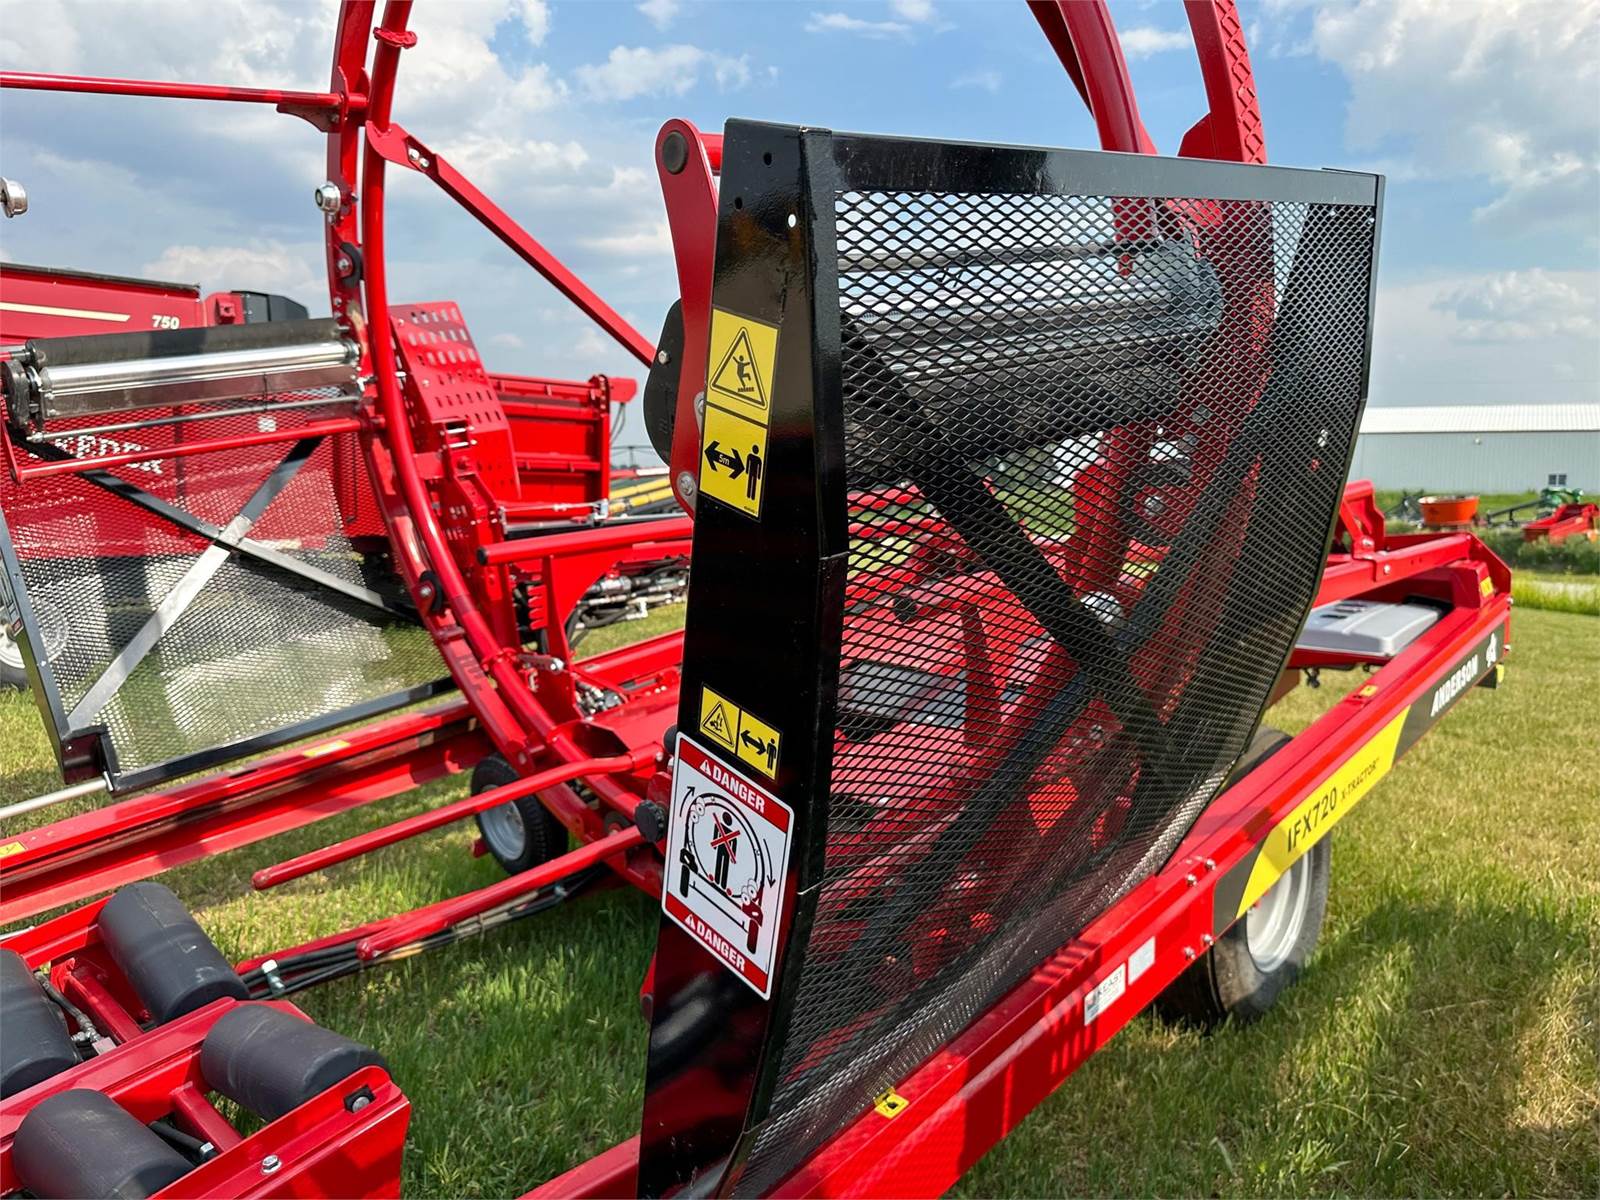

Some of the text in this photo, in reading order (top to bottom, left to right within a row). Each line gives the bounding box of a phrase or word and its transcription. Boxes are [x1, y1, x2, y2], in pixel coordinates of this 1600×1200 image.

[152, 314, 180, 330] 750
[718, 454, 730, 466] 5m
[1430, 654, 1478, 717] ANDERSON
[712, 764, 766, 814] DANGER
[1287, 786, 1337, 853] IFX720
[696, 919, 746, 973] DANGER
